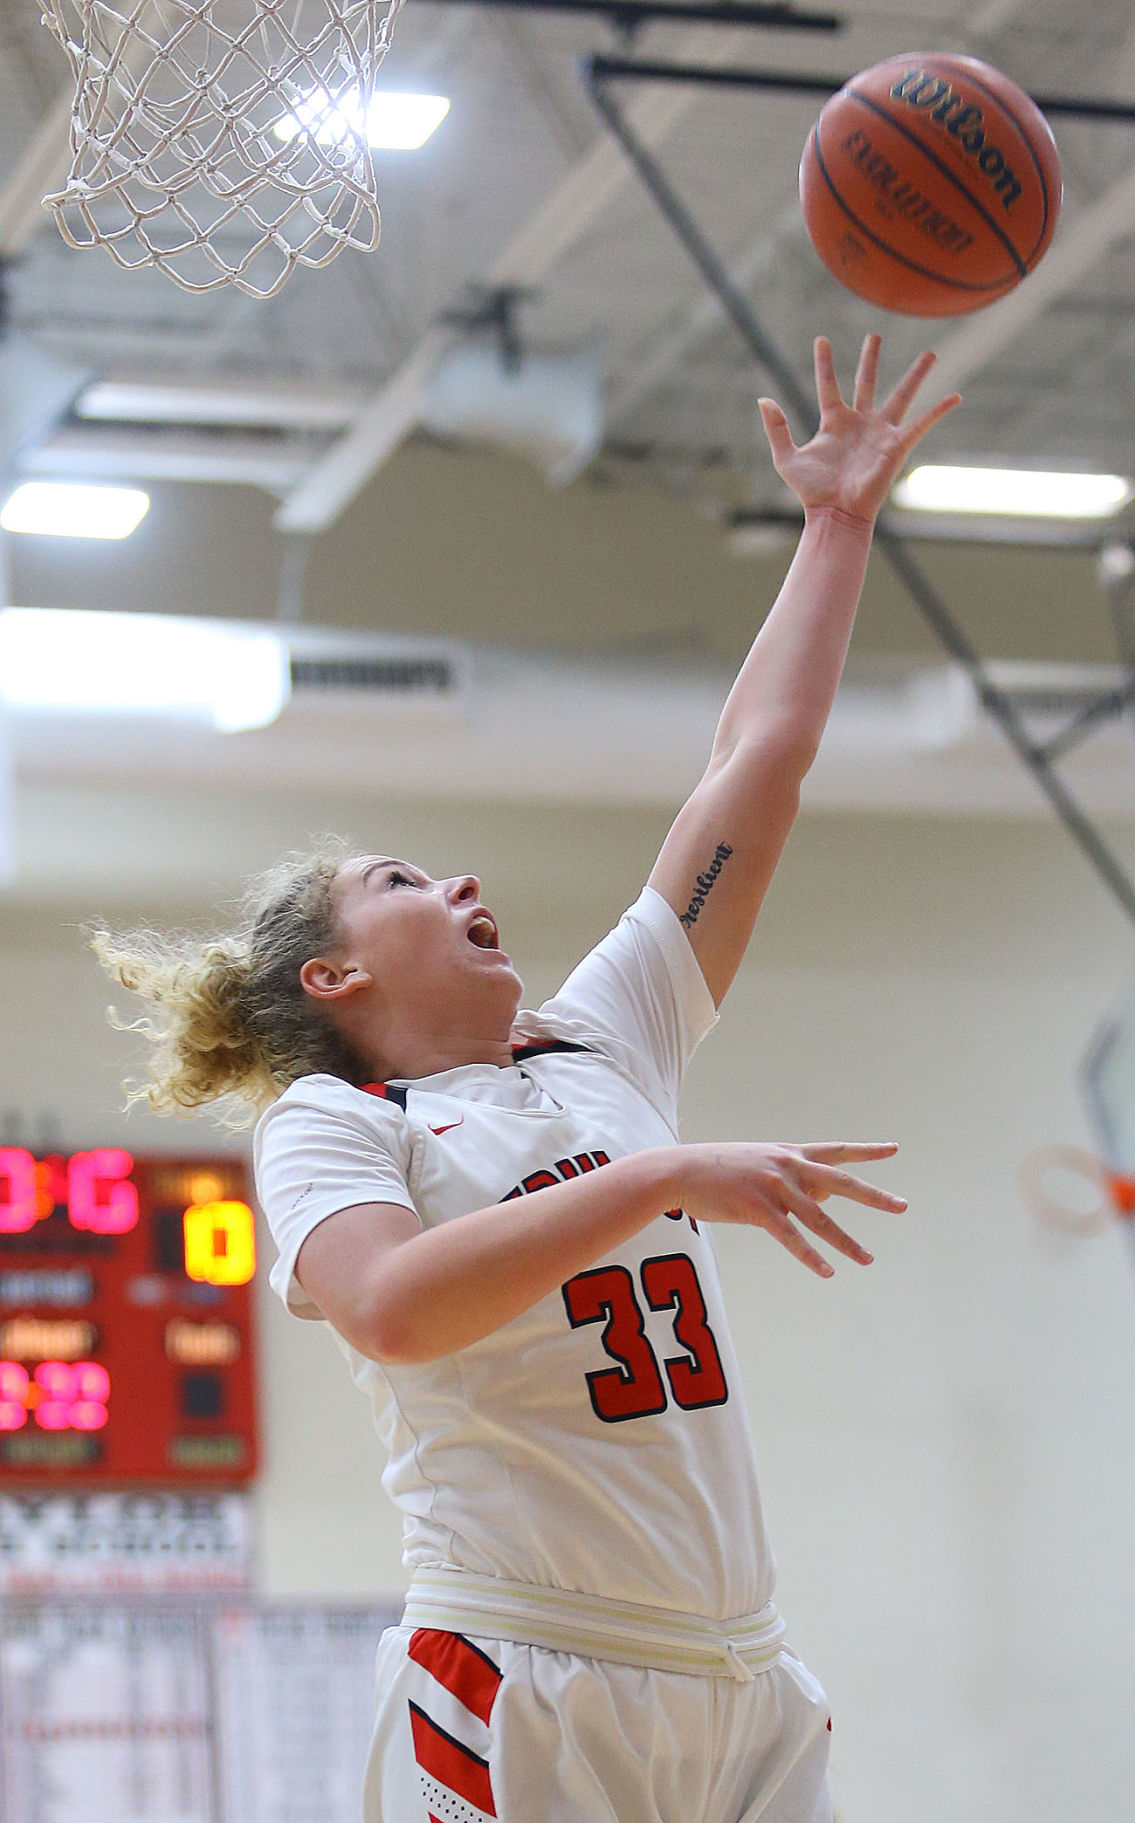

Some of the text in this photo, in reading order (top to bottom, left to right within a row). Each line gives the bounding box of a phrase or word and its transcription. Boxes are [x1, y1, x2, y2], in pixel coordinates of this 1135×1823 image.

[889, 69, 1023, 215] Wilson
[680, 840, 734, 929] resilient
[561, 1252, 729, 1424] 33
